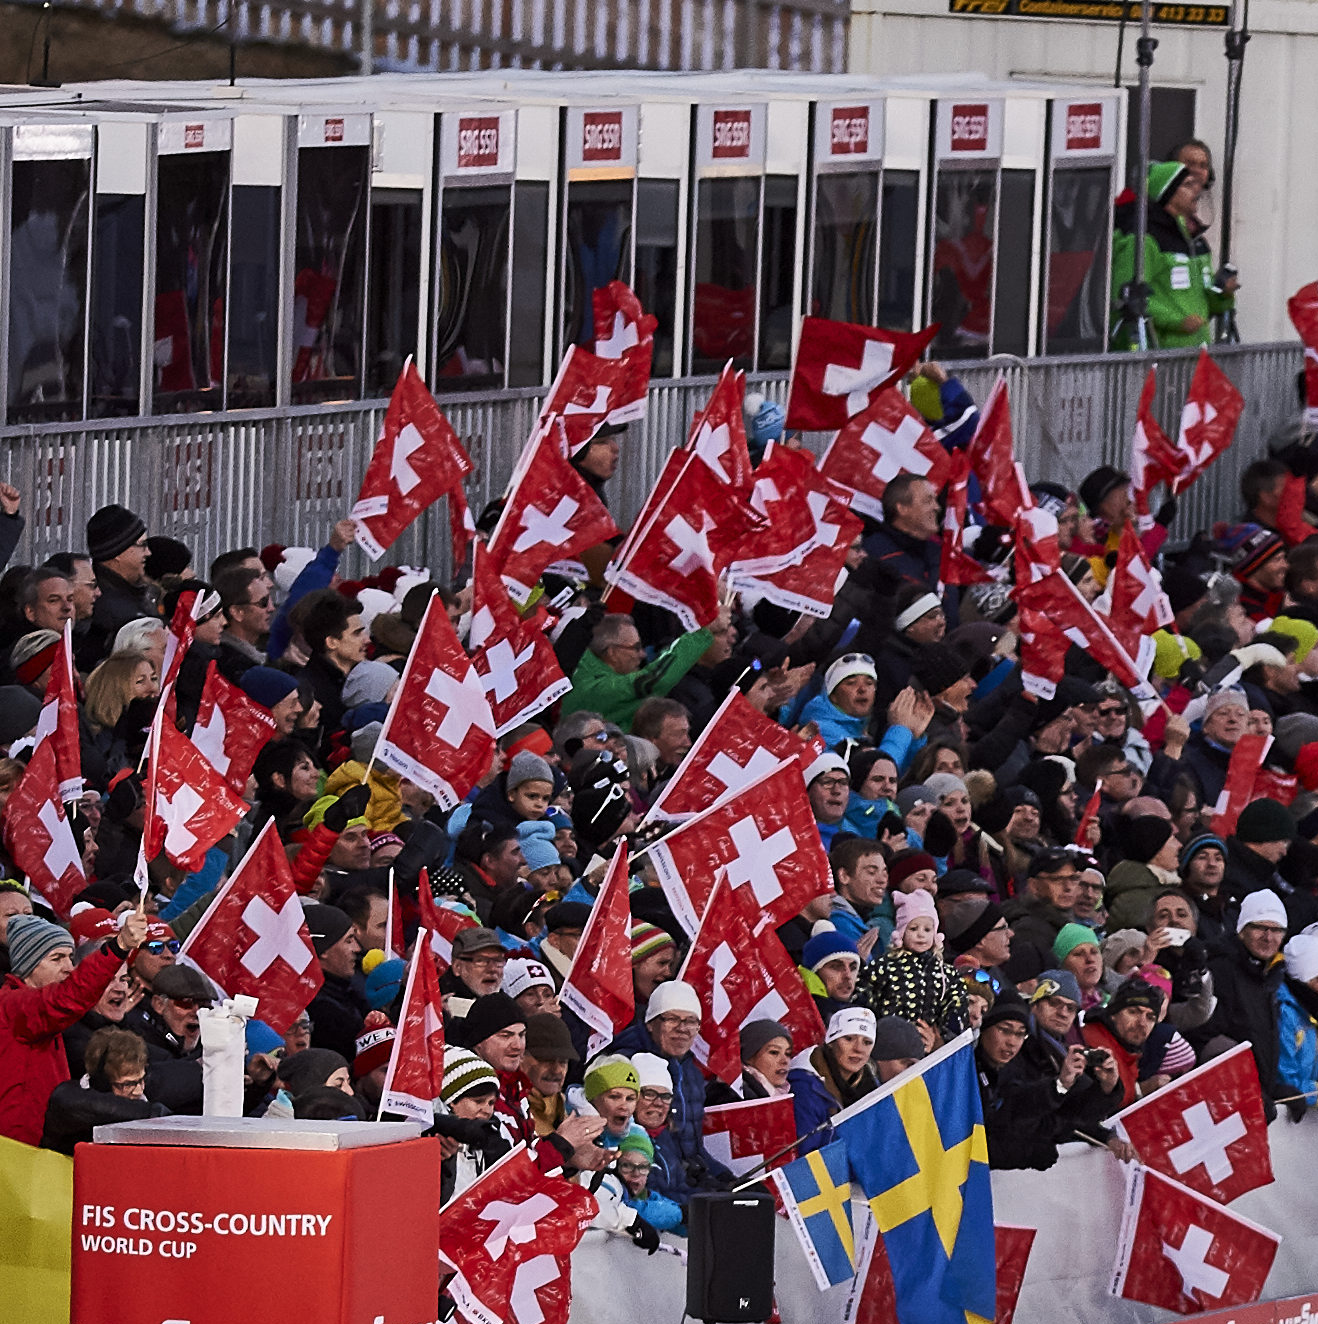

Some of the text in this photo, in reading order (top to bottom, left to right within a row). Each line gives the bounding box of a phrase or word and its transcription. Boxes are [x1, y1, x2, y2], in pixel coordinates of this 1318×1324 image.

[460, 130, 498, 155] SRG SSR
[584, 124, 620, 149] SRG SSR
[82, 1204, 333, 1238] FIS CROSS-COUNTRY
[81, 1234, 198, 1259] WORLD CUP
